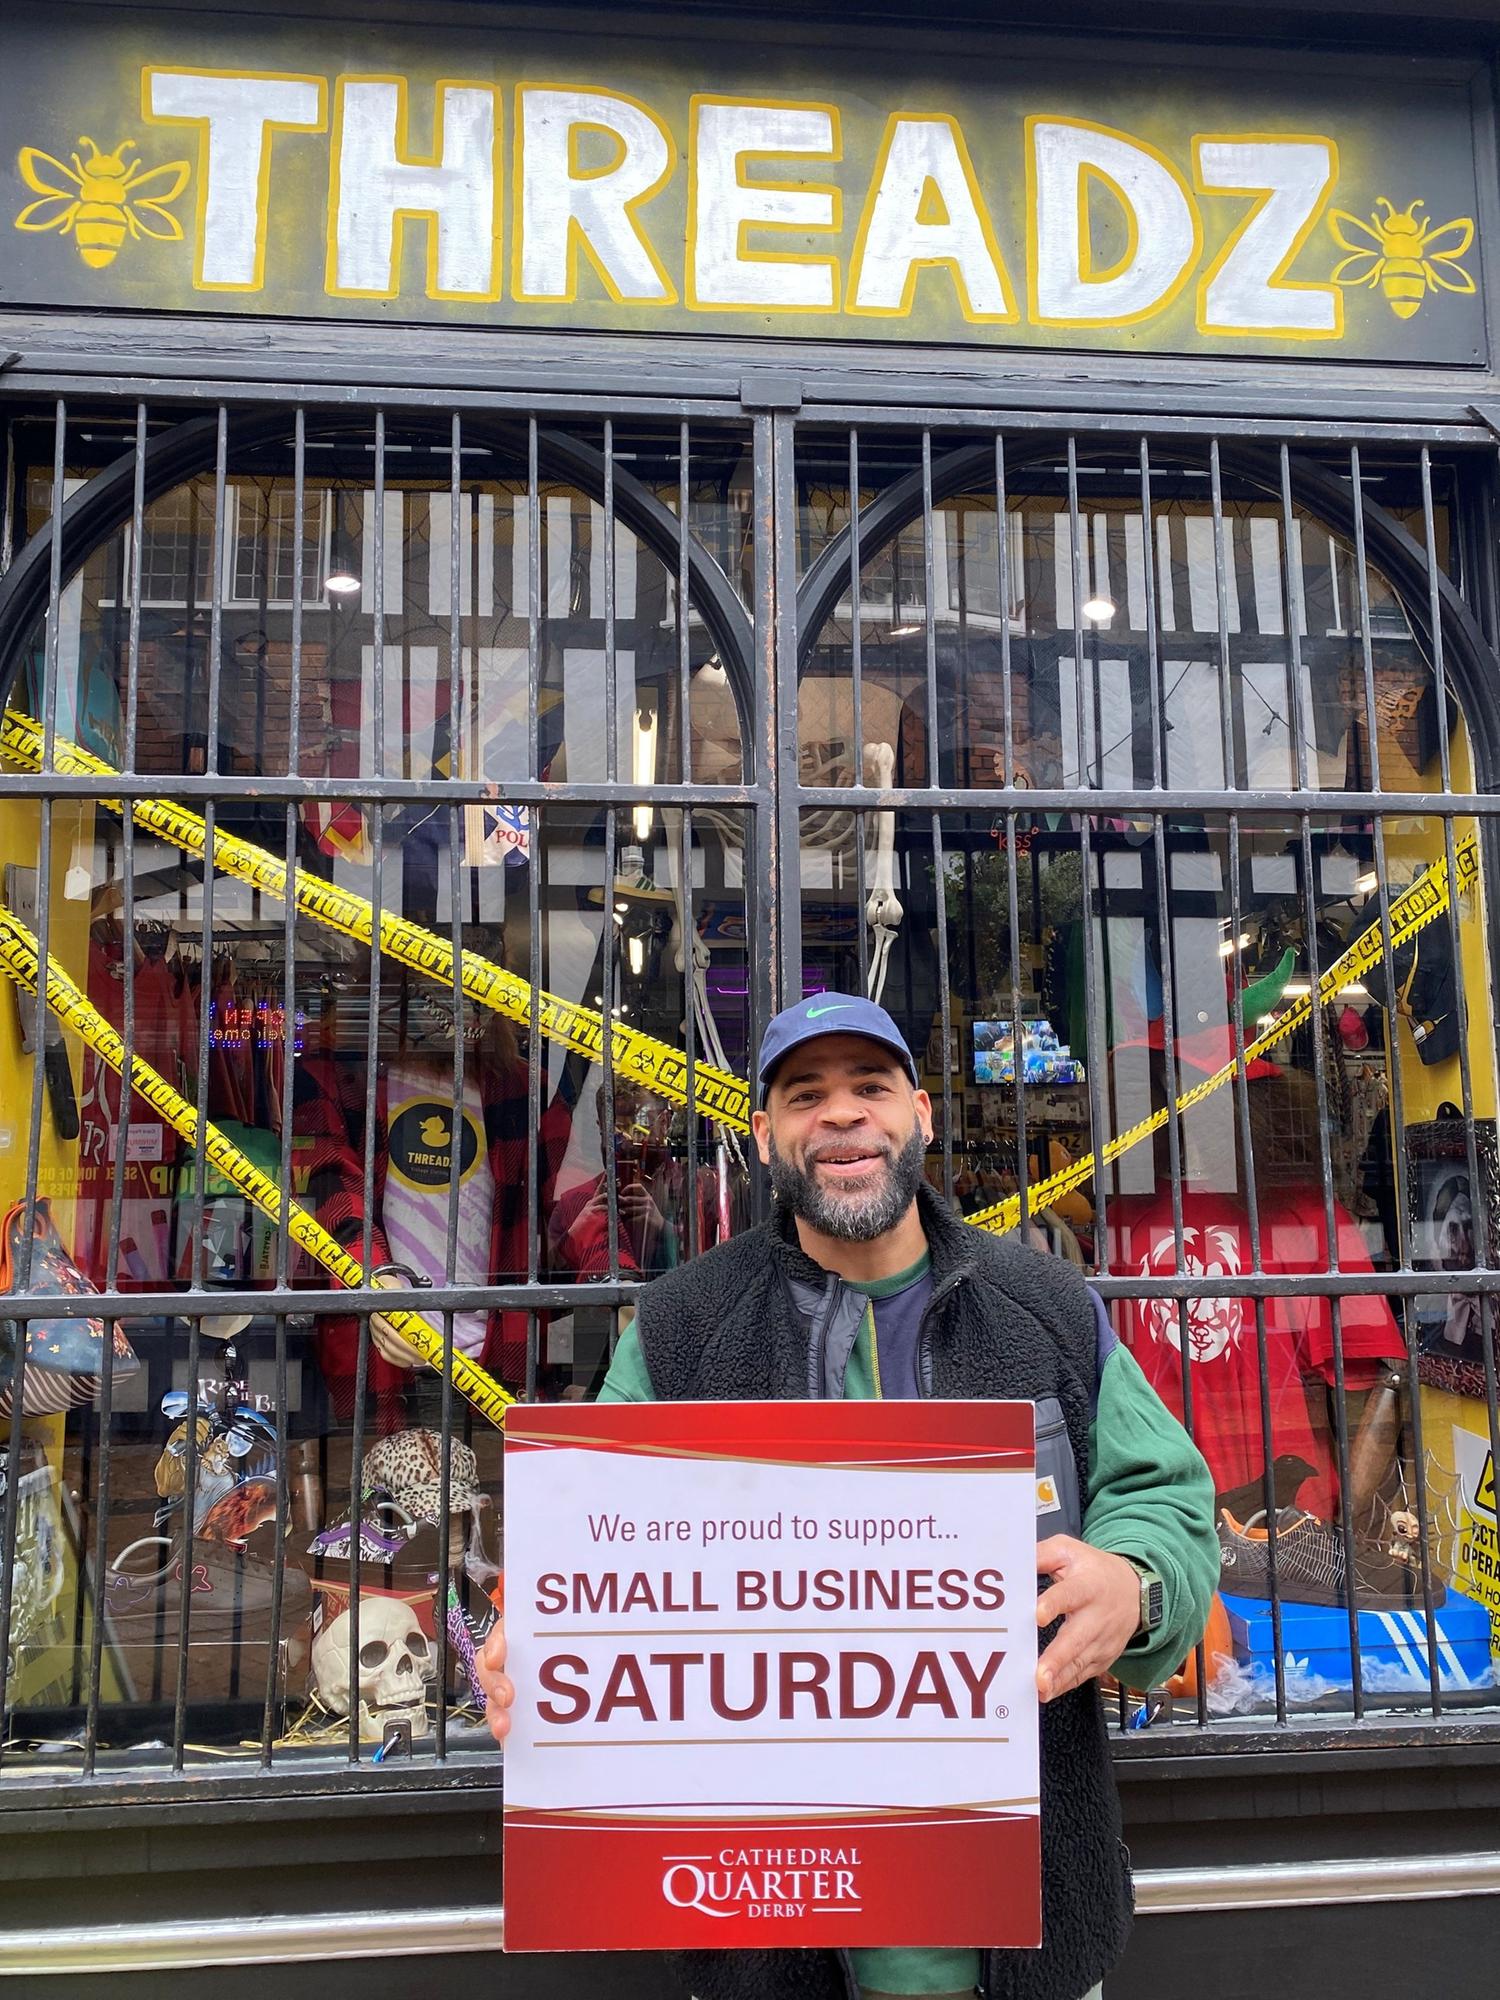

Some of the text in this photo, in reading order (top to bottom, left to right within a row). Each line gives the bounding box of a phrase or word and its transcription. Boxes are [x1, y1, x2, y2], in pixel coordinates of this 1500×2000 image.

[142, 66, 1343, 341] THREADZ
[2, 718, 95, 774] CAUTON
[131, 798, 227, 859] AUTION
[388, 928, 496, 997] CAUTON
[496, 830, 528, 848] POL
[999, 832, 1031, 850] KSS
[1358, 879, 1441, 959] CATION
[0, 924, 80, 1015] CAUTON
[429, 1345, 505, 1423] CAUTIO
[408, 1151, 454, 1167] THREAD
[588, 1512, 958, 1547] We are proud to support...
[1472, 1522, 1500, 1549] CCT
[535, 1568, 1006, 1615] SMALL BUSINESS
[536, 1650, 1007, 1725] SATURDAY
[719, 1848, 861, 1866] CATHEDRAL
[662, 1863, 861, 1918] QUARTER
[748, 1903, 806, 1918] DERBY
